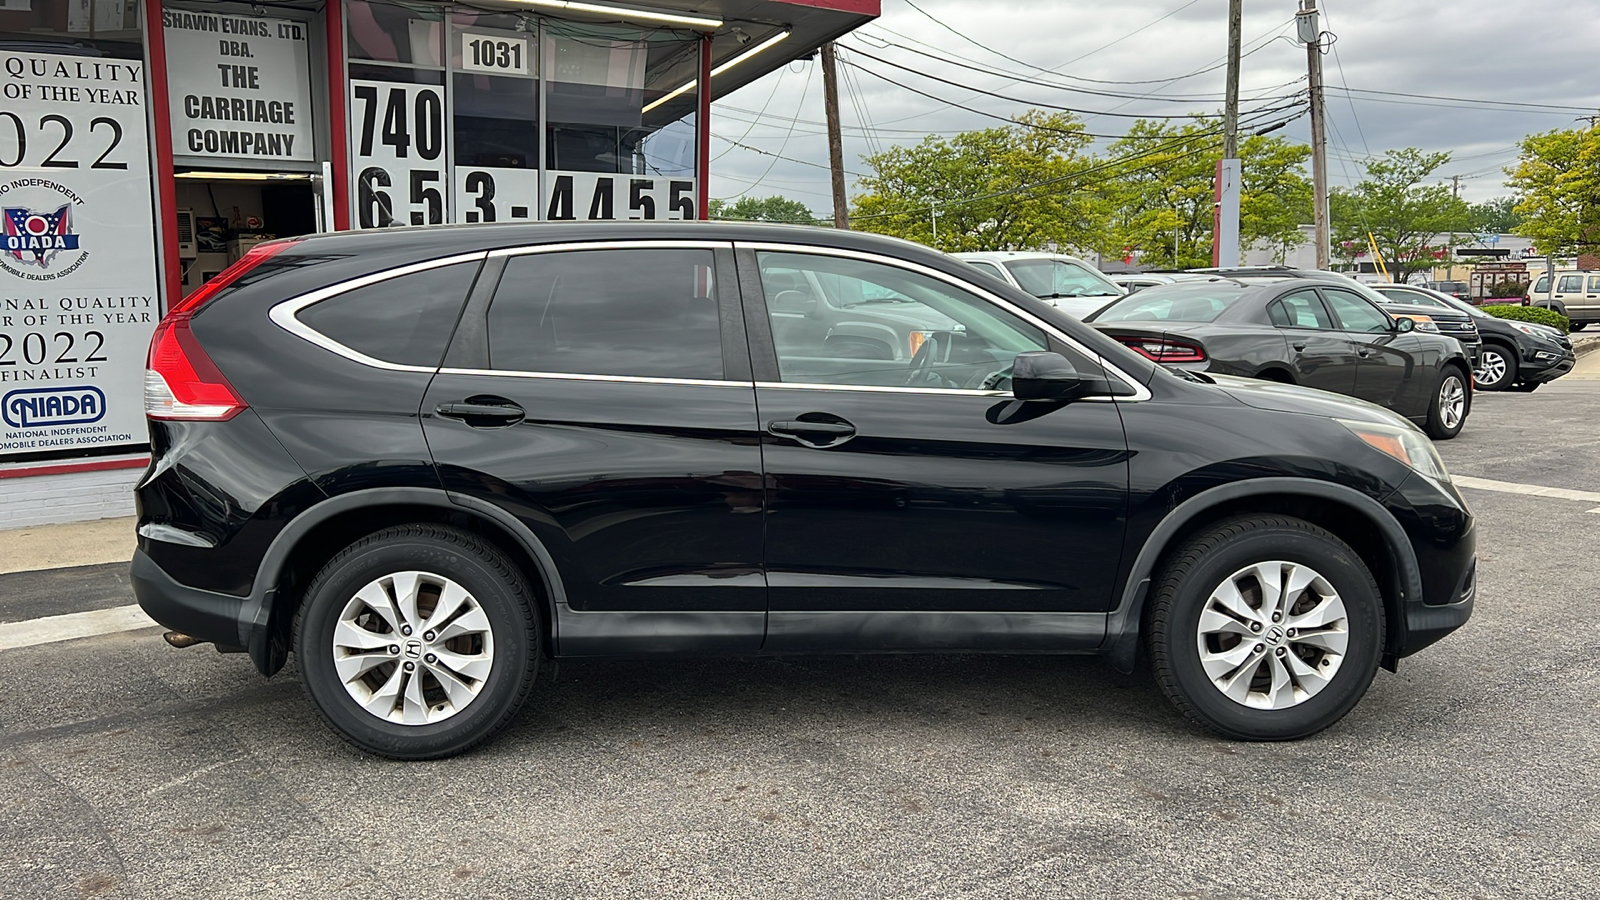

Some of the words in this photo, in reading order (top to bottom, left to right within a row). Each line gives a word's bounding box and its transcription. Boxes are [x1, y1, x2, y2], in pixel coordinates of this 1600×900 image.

[162, 11, 218, 32] SHAWN
[222, 18, 272, 38] EVANS.
[278, 23, 306, 41] LTD.
[220, 40, 254, 58] DBA.
[470, 39, 521, 69] 1031
[5, 57, 140, 83] QUALITY
[217, 63, 260, 90] THE
[3, 83, 32, 99] OF
[37, 85, 81, 102] THE
[85, 88, 140, 105] YEAR
[184, 94, 295, 125] CARRIAGE
[354, 85, 442, 160] 740
[187, 128, 295, 157] COMPANY
[10, 178, 85, 206] INDEPENDENT
[7, 235, 66, 249] OIADA
[26, 273, 56, 281] DEALERS
[57, 250, 90, 279] ASSOCIATION
[59, 296, 152, 312] QUALITY
[24, 314, 48, 326] OF
[57, 313, 95, 325] THE
[103, 312, 151, 324] YEAR
[0, 330, 108, 366] 2022
[1, 366, 99, 382] FINALIST
[10, 393, 97, 423] NIADA
[5, 429, 49, 440] NATIONAL
[51, 425, 108, 437] INDEPENDENT
[38, 438, 74, 448] DEALERS
[76, 433, 132, 444] ASSOCIATION
